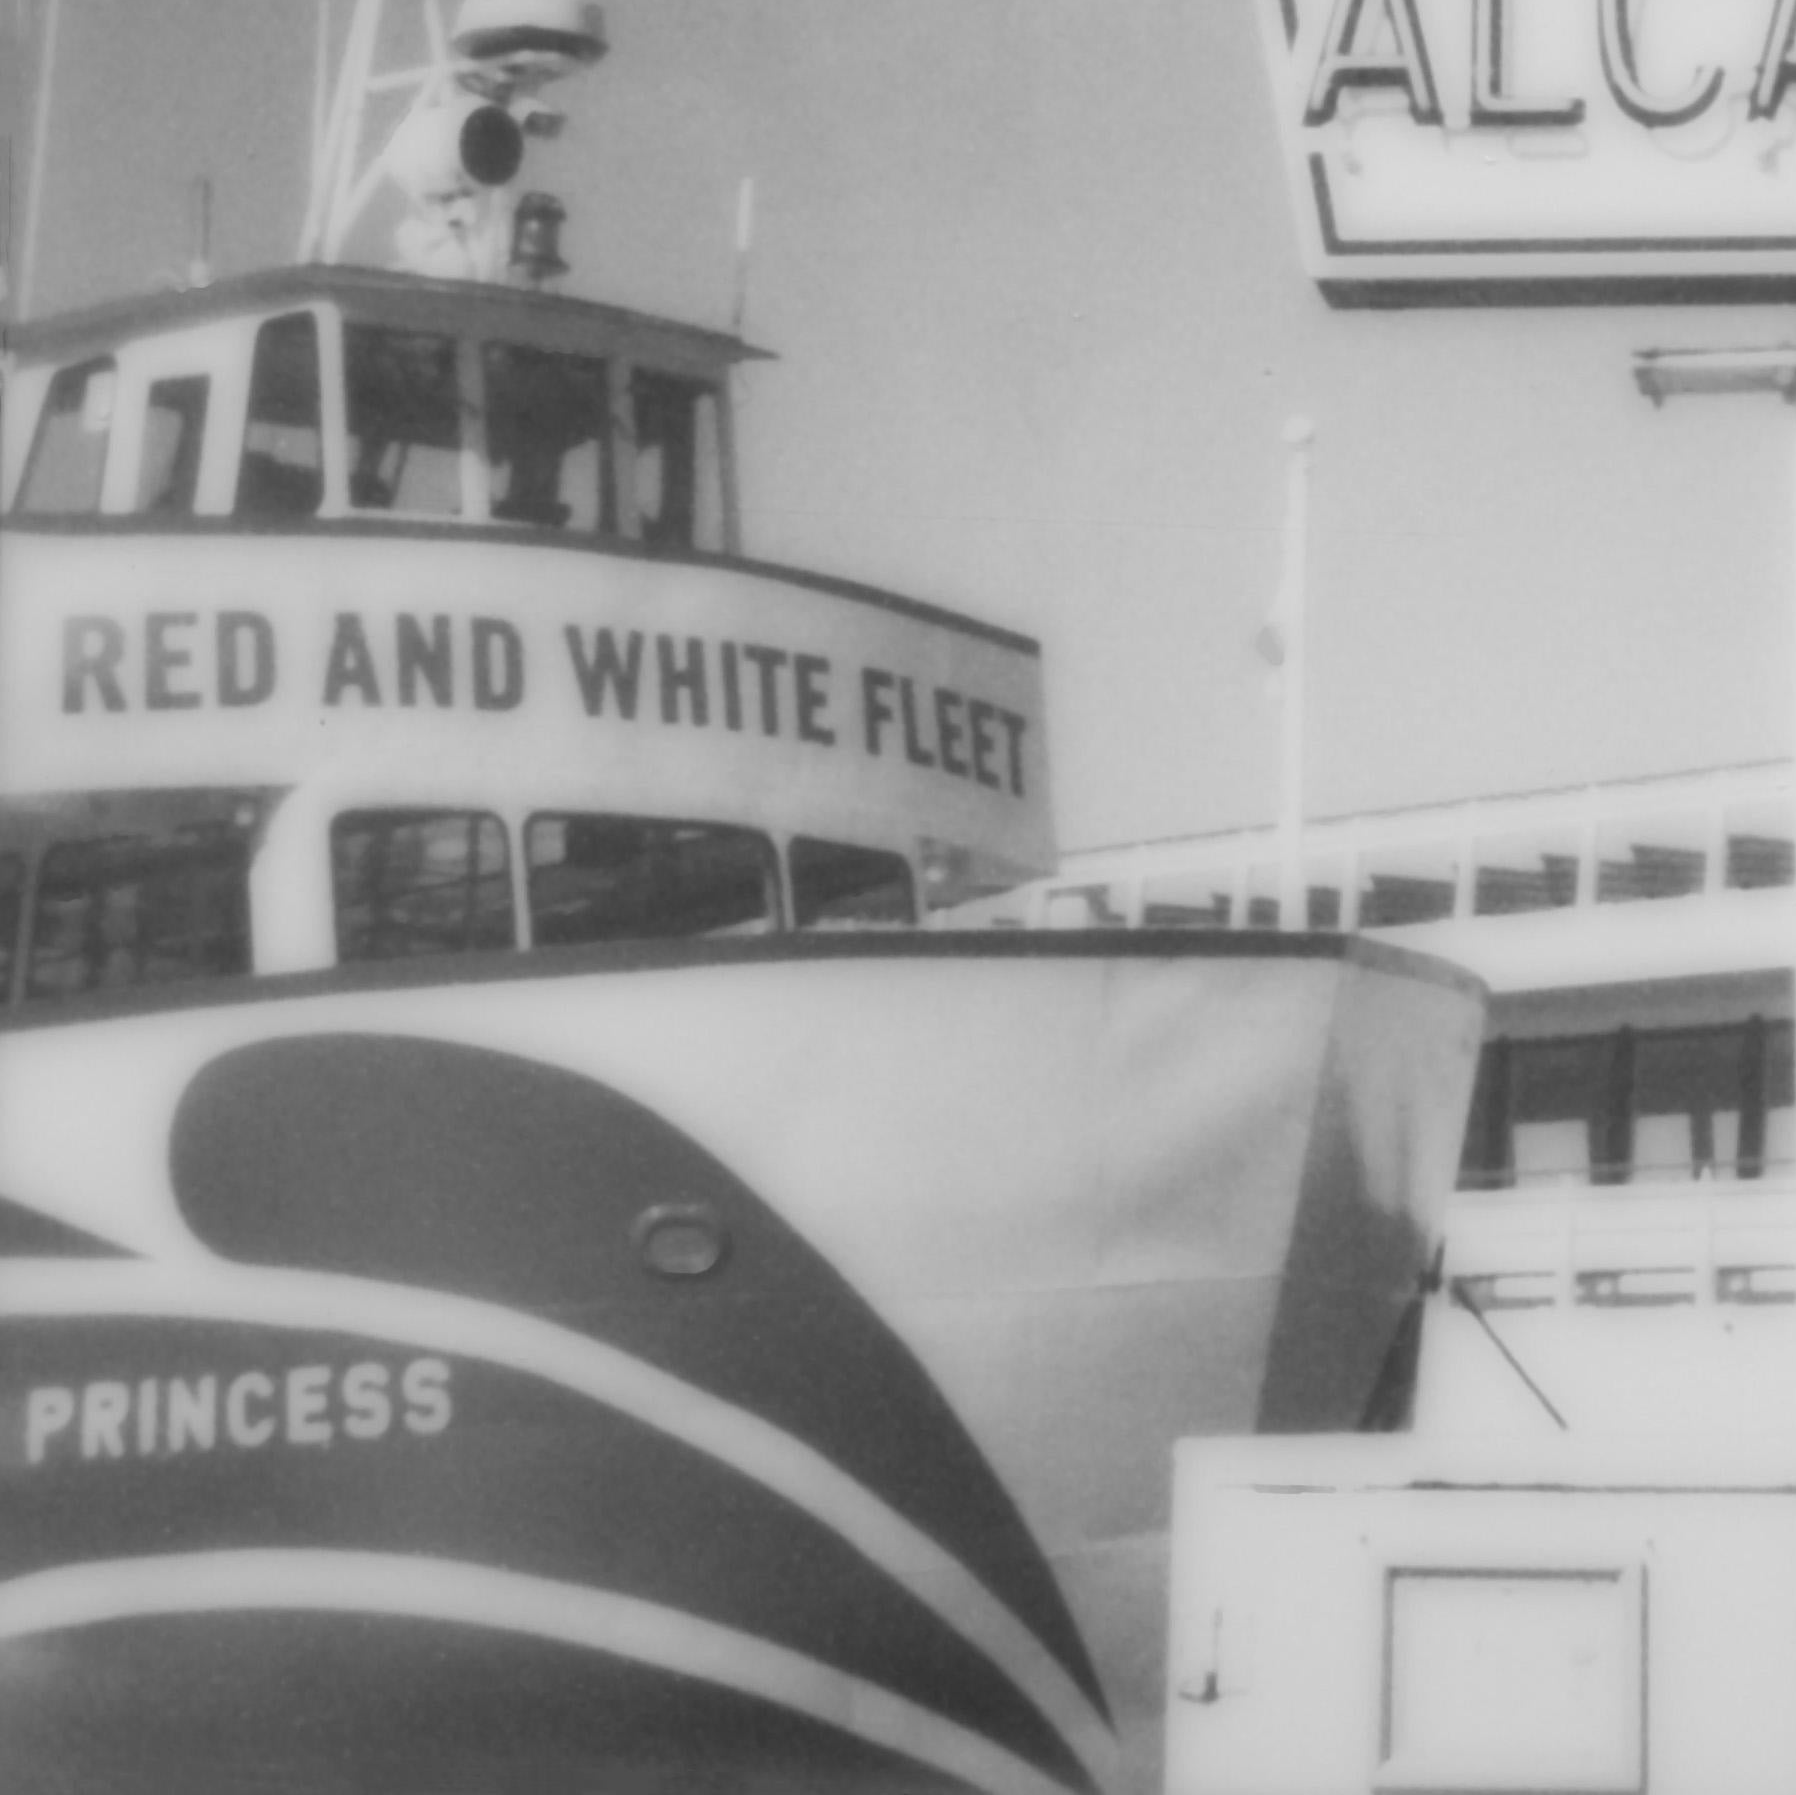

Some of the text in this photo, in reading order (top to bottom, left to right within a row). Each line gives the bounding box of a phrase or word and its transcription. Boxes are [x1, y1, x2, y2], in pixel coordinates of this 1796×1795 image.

[60, 610, 1029, 799] RED AND WHITE FLEET
[26, 1358, 453, 1464] PRINCESS
